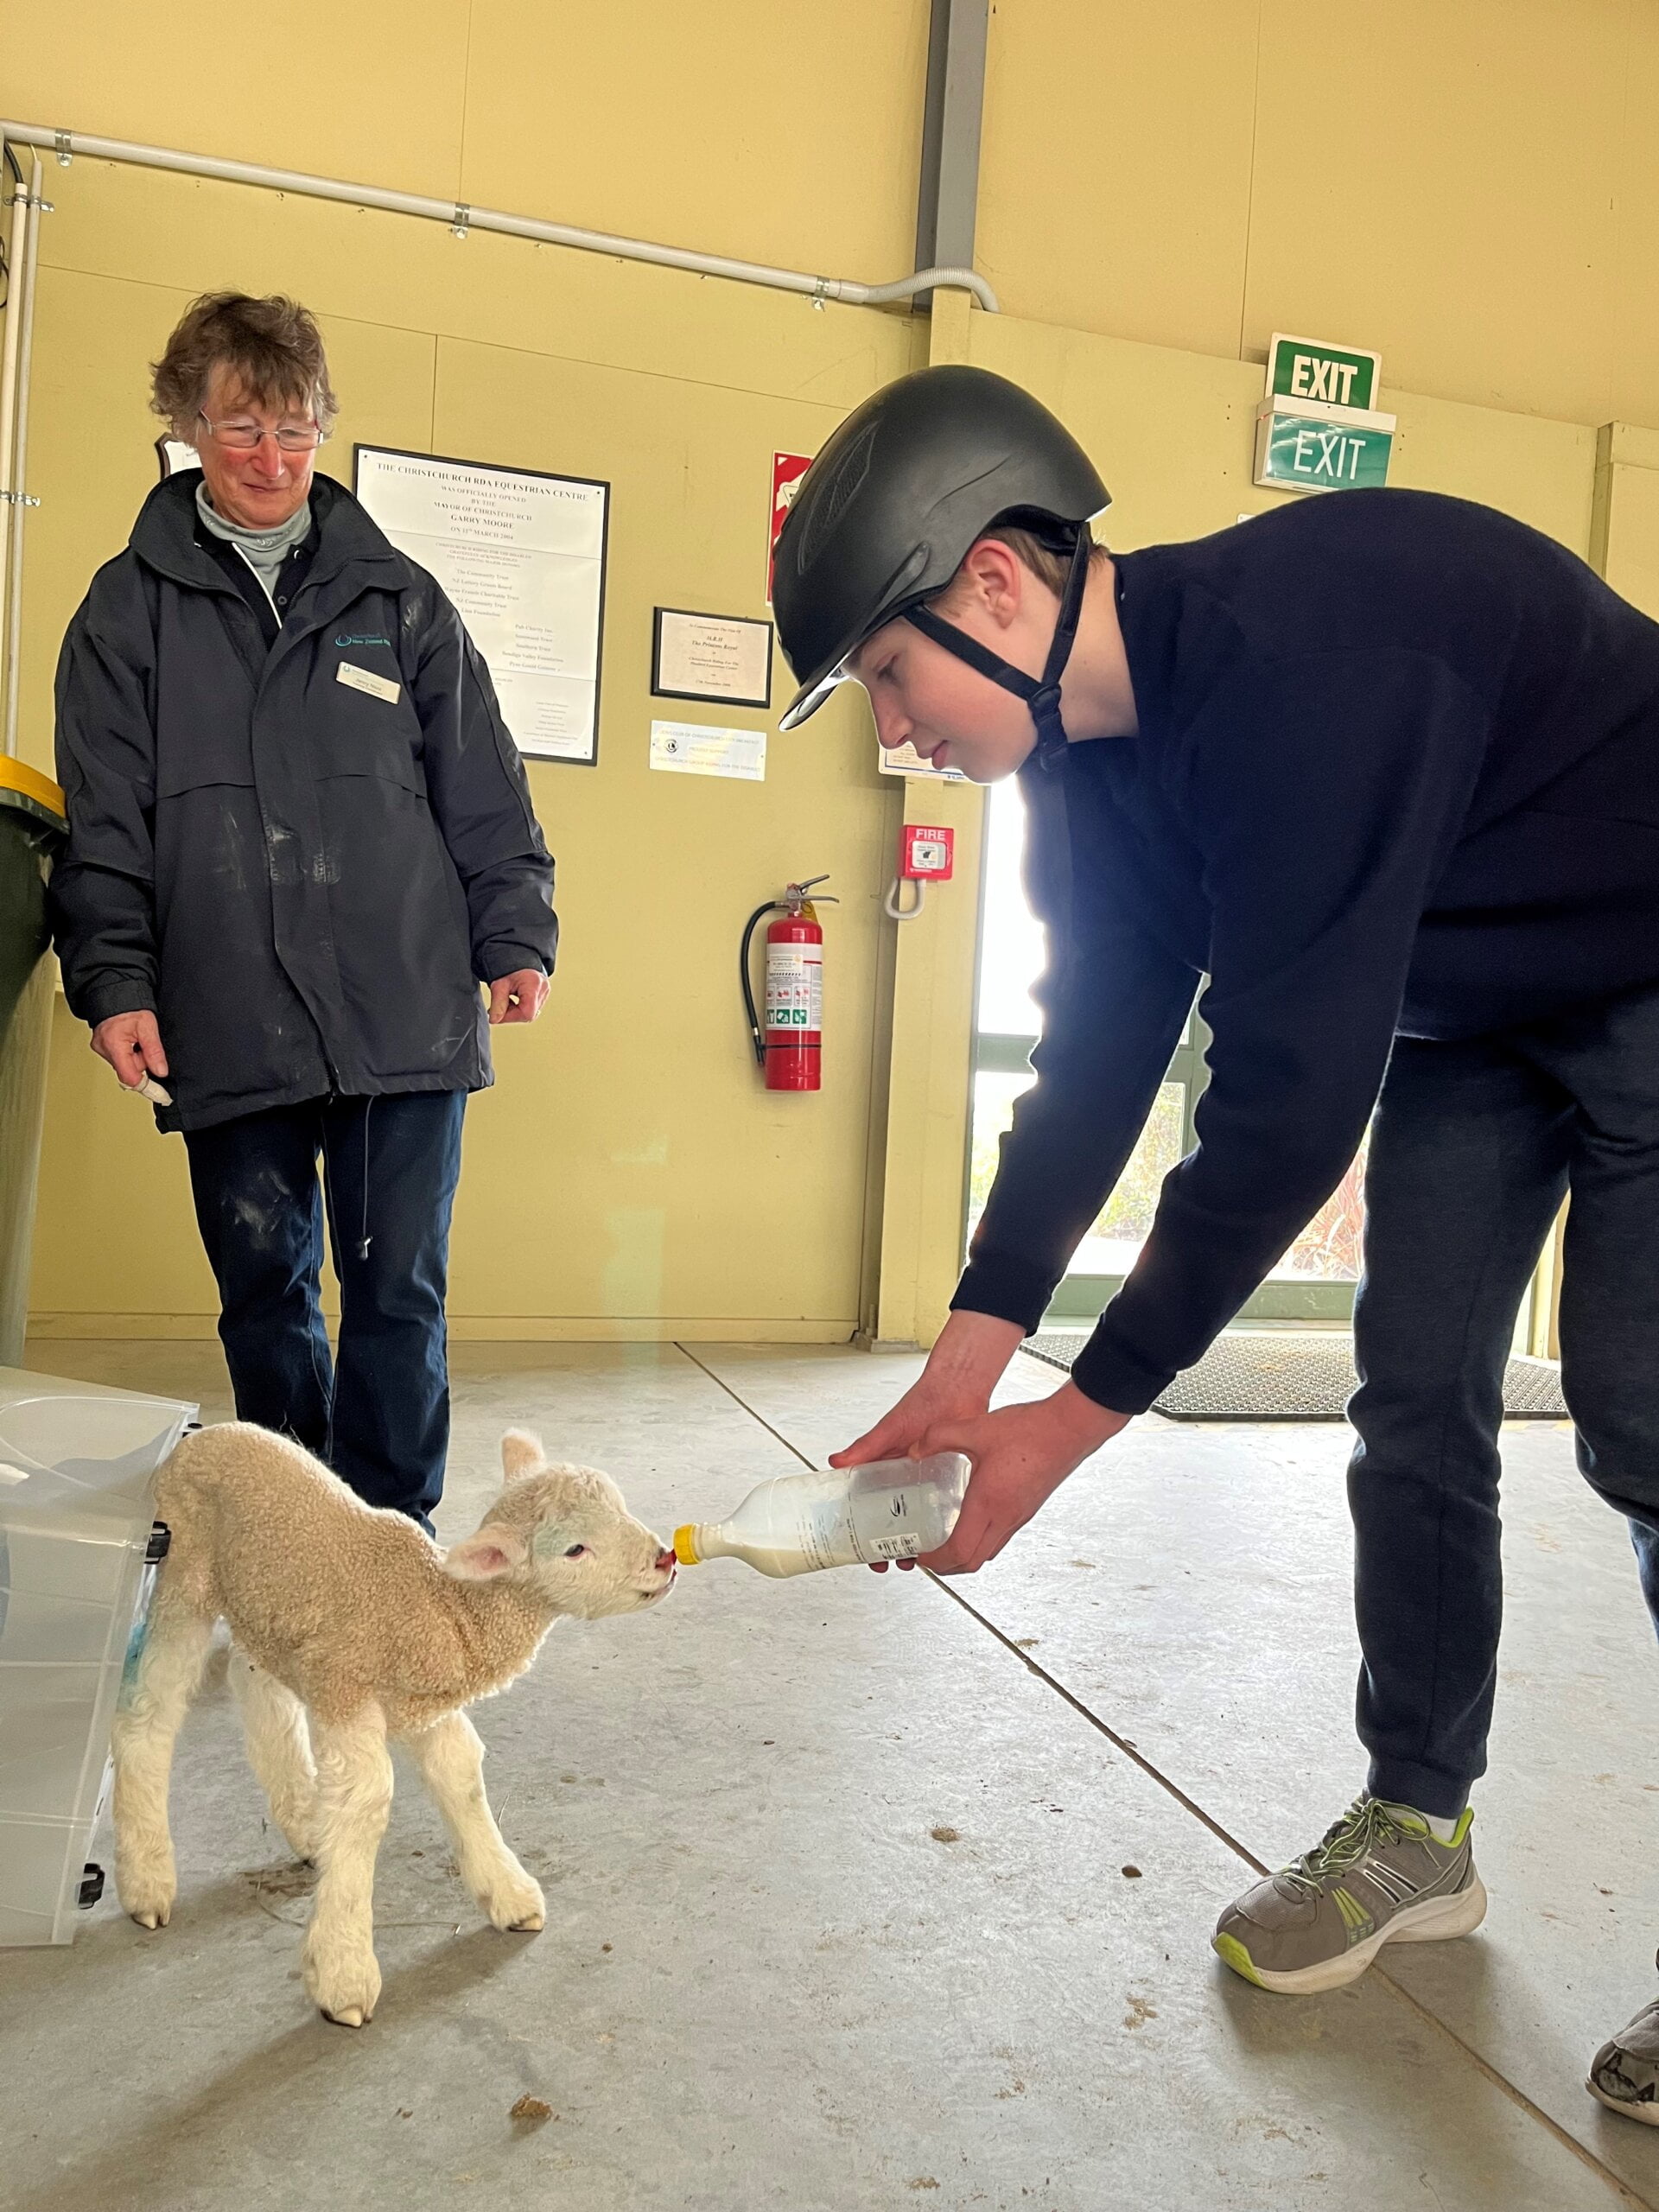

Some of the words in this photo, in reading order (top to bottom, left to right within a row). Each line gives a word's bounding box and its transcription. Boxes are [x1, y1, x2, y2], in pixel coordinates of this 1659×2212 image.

[1291, 354, 1357, 404] EXIT
[1294, 429, 1366, 480] EXIT
[378, 462, 395, 472] THE
[397, 465, 470, 483] CHRISTCHURCH
[474, 477, 492, 486] RDA
[494, 480, 550, 497] EQUESTRIAN
[553, 490, 588, 502] CENTRE
[456, 487, 496, 499] OFFICIALLY
[499, 493, 526, 503] OPENED
[434, 501, 460, 510] MAYOR
[474, 507, 532, 521] CHRISTCHURCH
[450, 513, 480, 524] GARRY
[483, 518, 513, 530] MOORE
[474, 529, 499, 538] MARCH
[916, 829, 945, 841] FIRE
